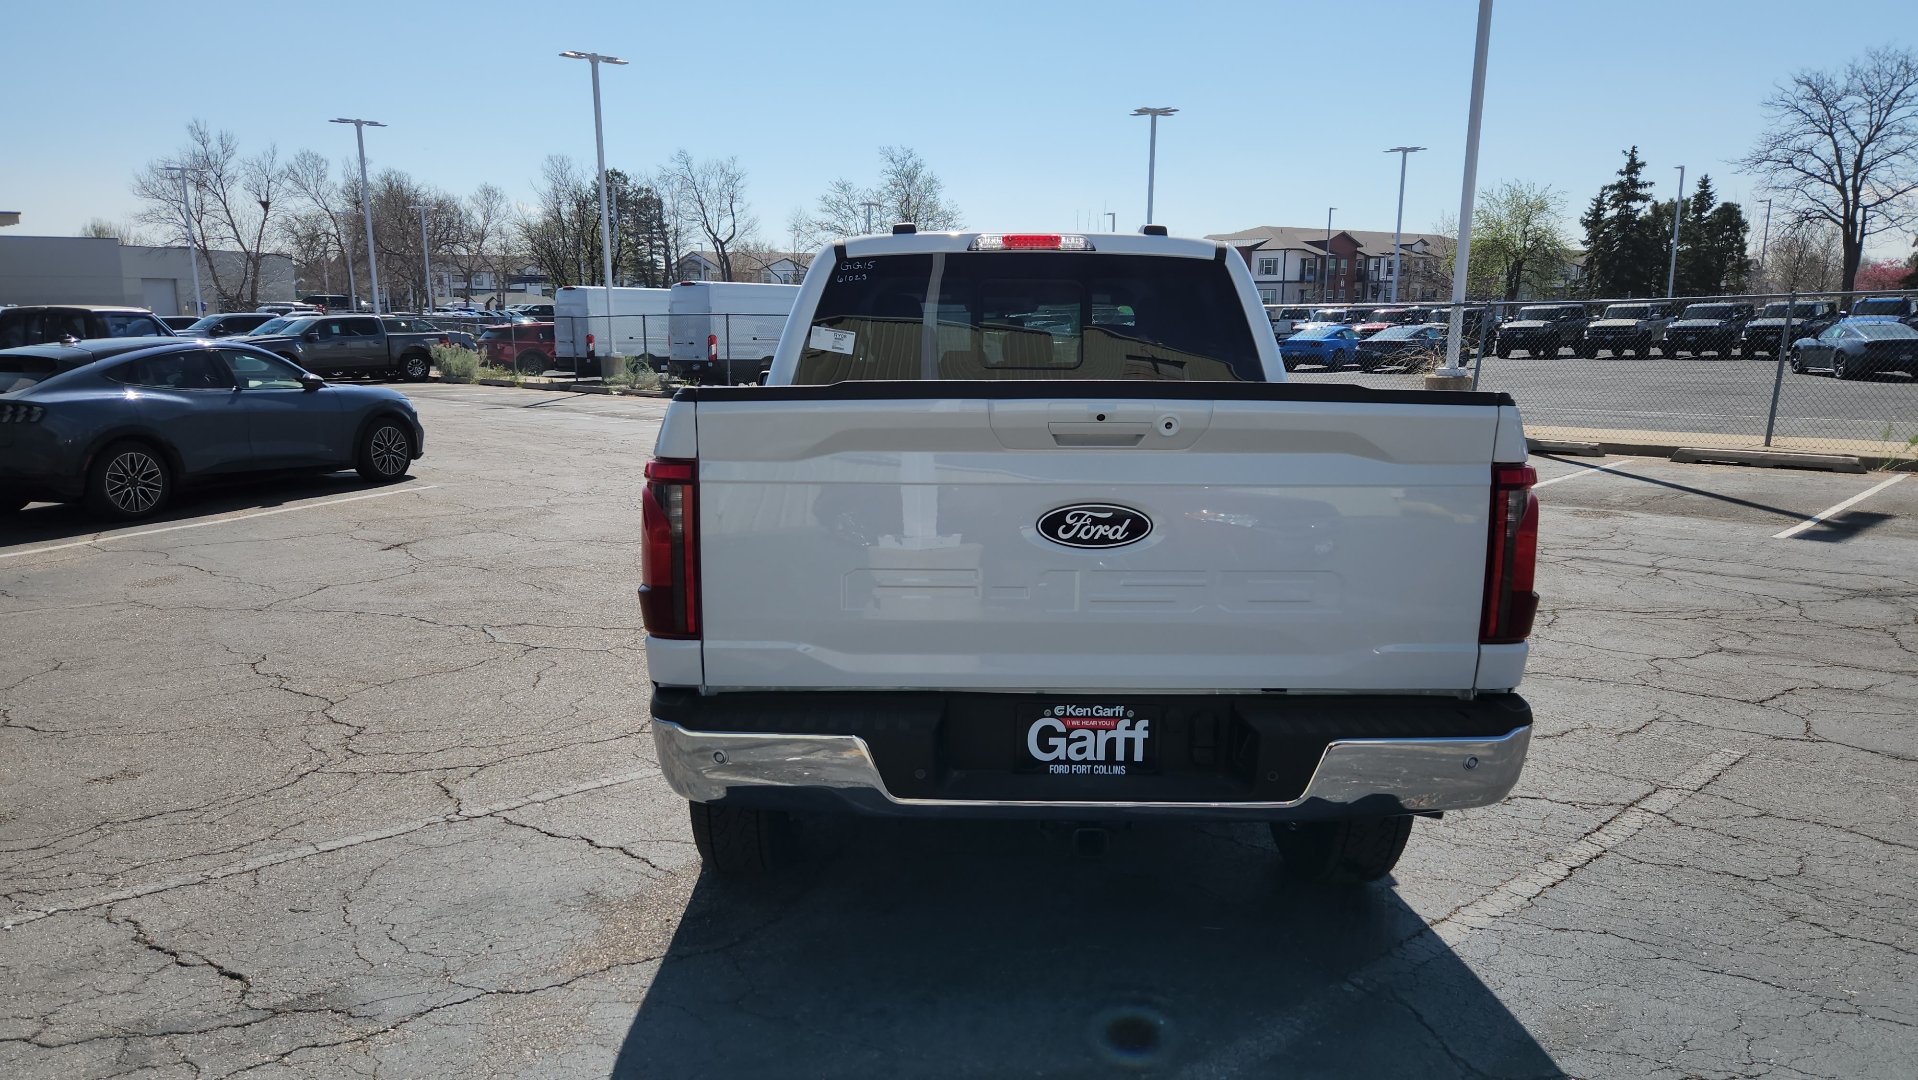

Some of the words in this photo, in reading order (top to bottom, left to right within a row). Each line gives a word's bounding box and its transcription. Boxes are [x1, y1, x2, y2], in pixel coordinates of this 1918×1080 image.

[1057, 510, 1132, 540] Ford
[1066, 704, 1091, 717] Ken
[1092, 705, 1125, 717] Garff
[1027, 717, 1149, 762] Garff
[1049, 764, 1070, 774] FORD
[1071, 764, 1092, 775] FORT
[1093, 765, 1126, 775] COLLINS
